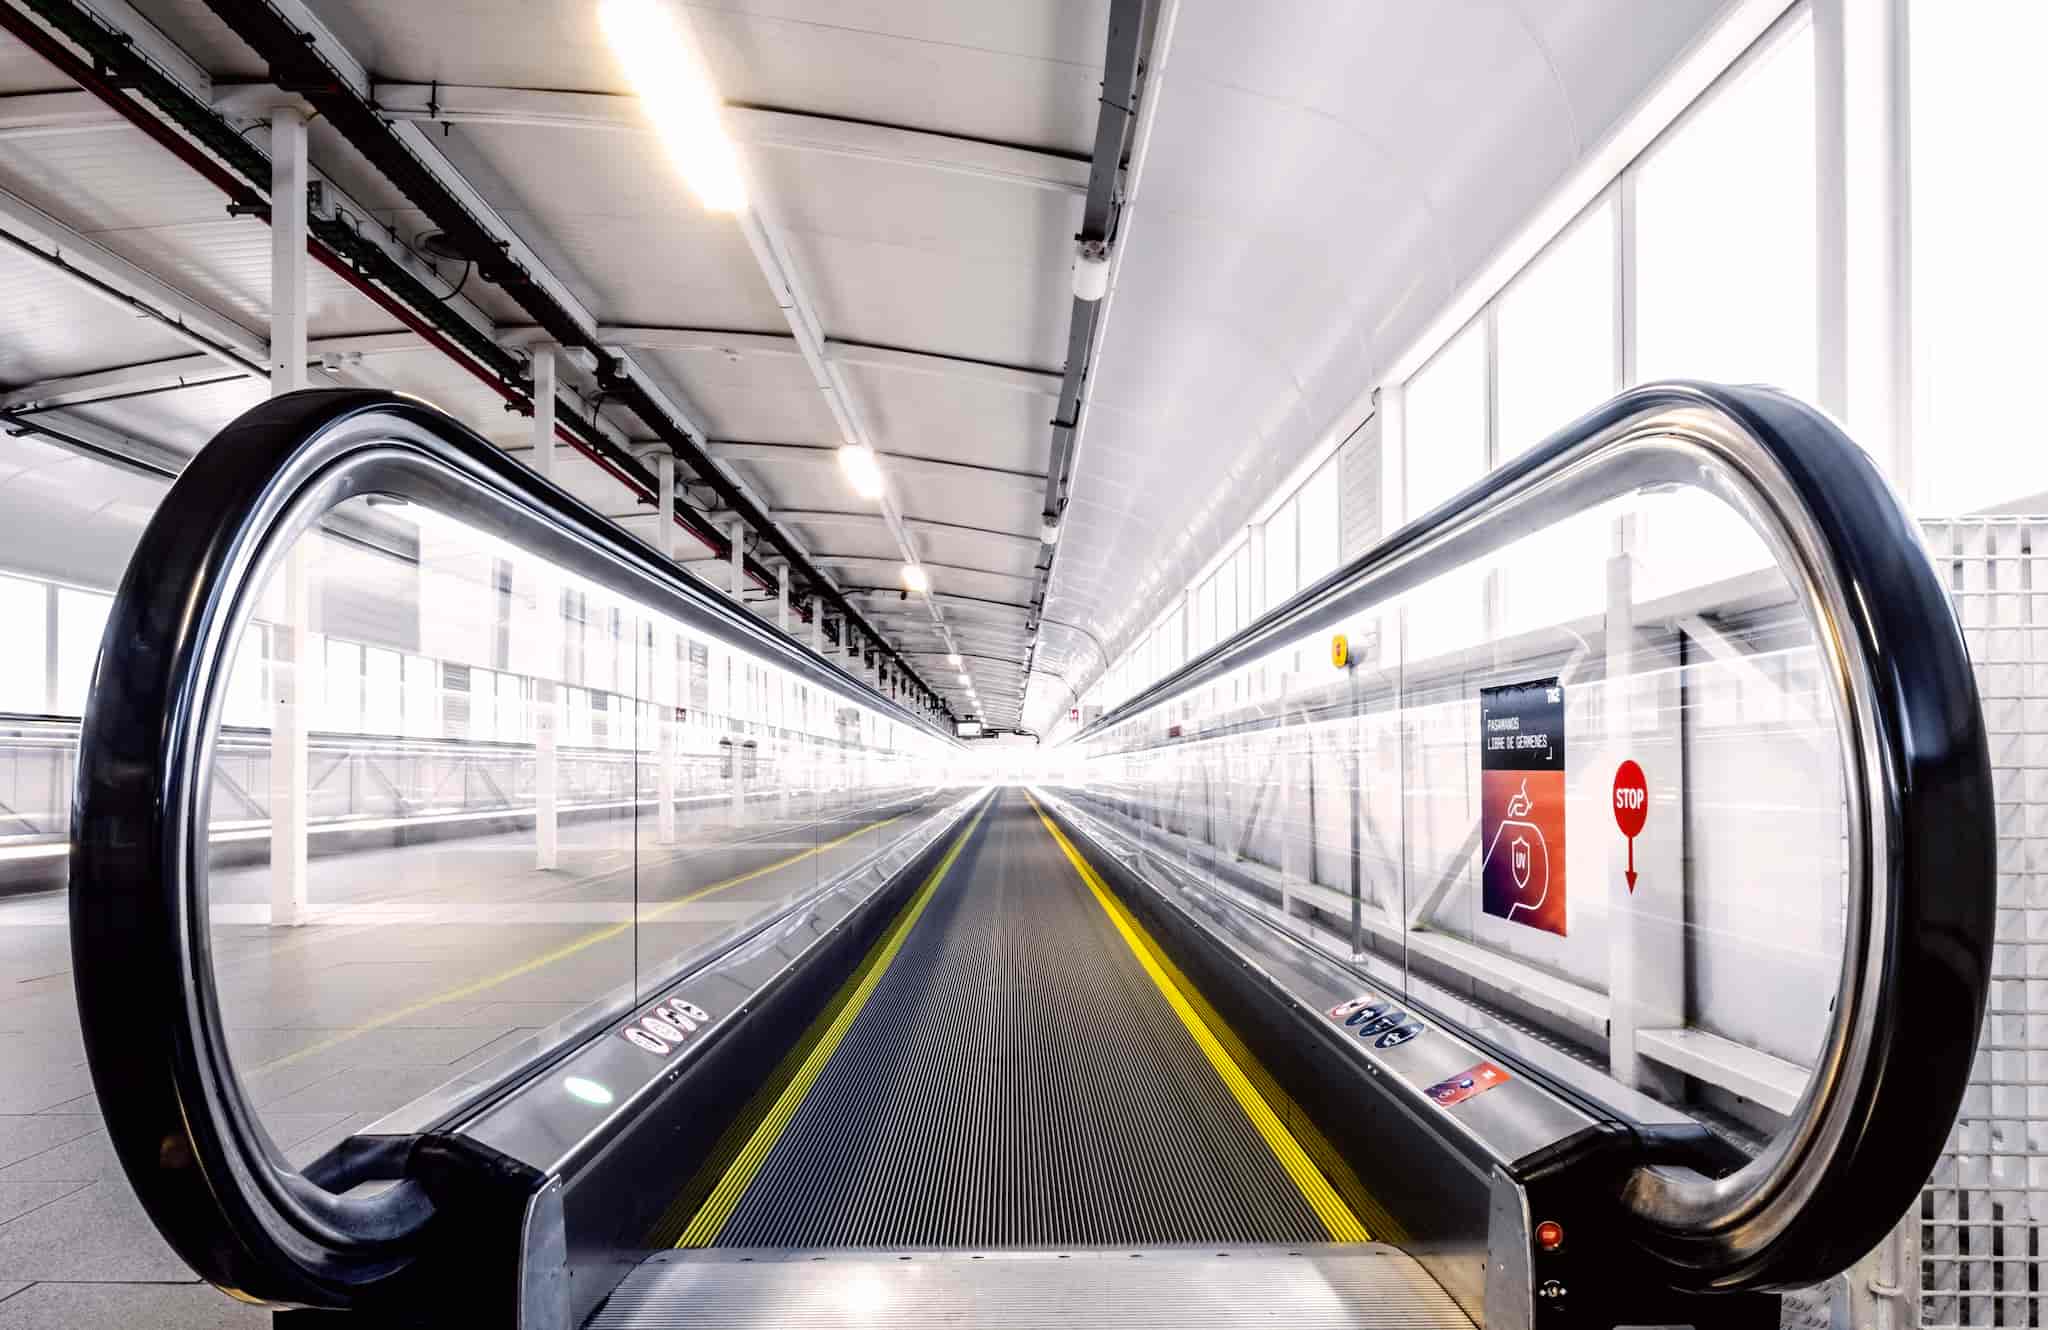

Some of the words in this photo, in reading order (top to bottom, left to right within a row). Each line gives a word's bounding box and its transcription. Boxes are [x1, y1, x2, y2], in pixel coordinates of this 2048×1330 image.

[1488, 736, 1505, 750] LIBRE
[1506, 736, 1514, 749] DE
[1616, 788, 1644, 810] STOP
[1515, 851, 1526, 869] UV
